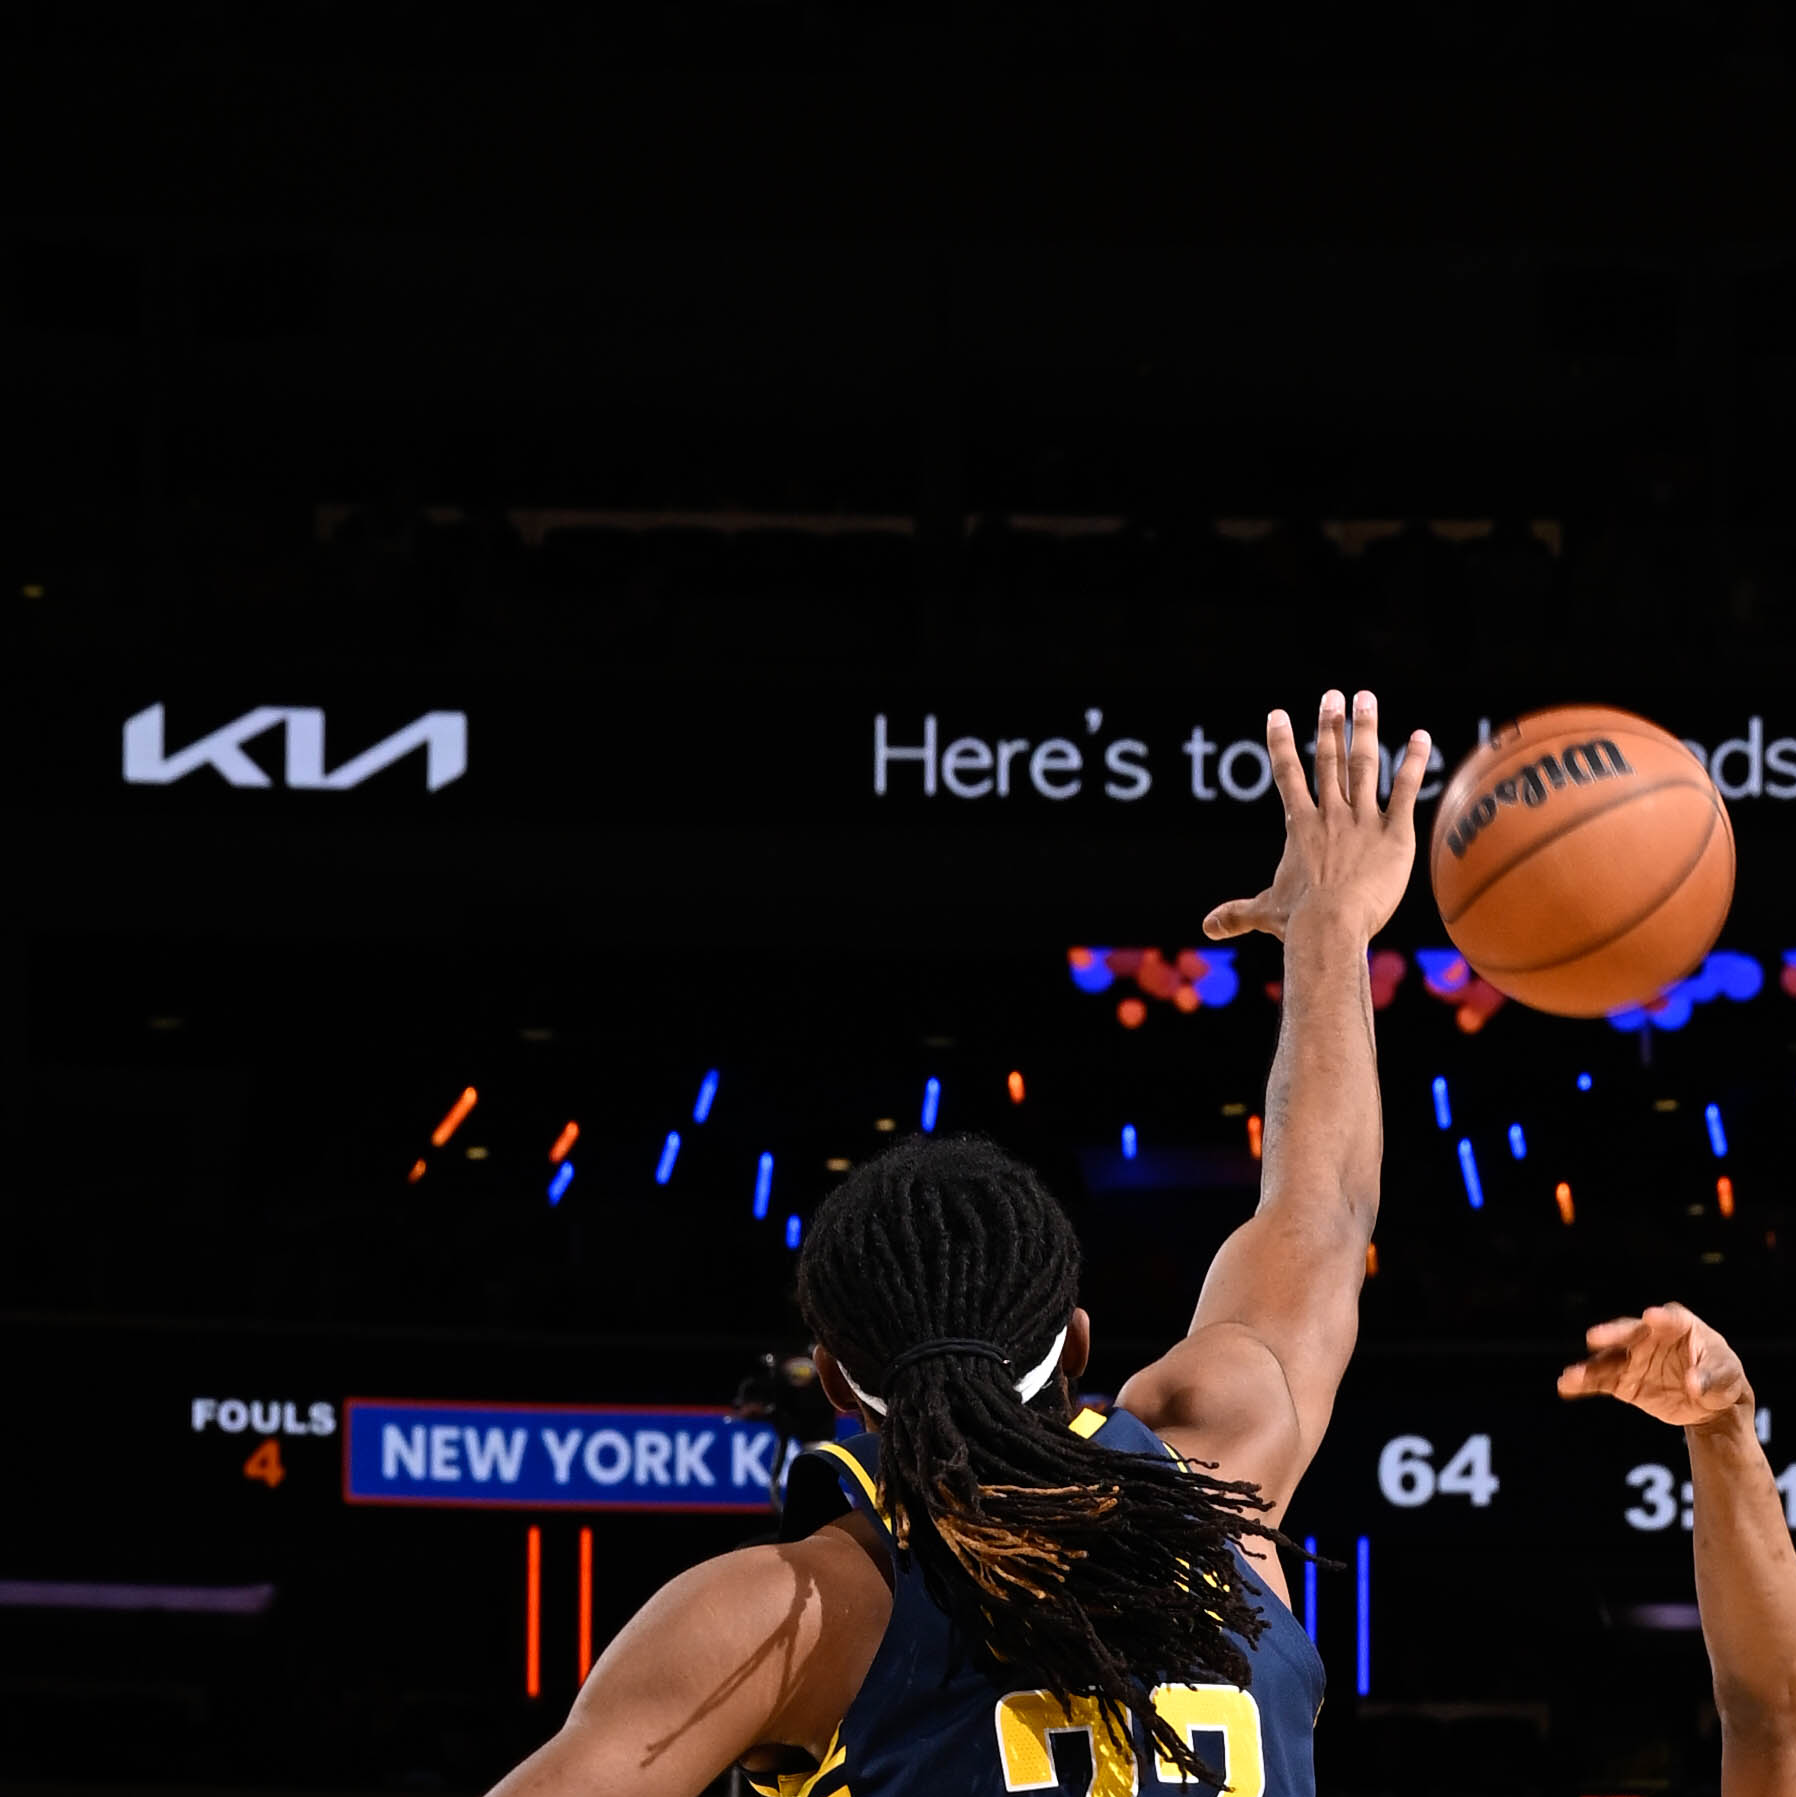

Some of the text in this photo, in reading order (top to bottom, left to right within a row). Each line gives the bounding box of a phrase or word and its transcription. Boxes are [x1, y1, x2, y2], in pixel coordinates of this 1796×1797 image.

[874, 708, 1152, 801] Here’s
[1183, 724, 1274, 802] to
[1447, 738, 1638, 858] Wilson
[191, 1397, 337, 1436] FOULS
[243, 1438, 286, 1489] 4
[383, 1425, 526, 1482] NEW
[543, 1430, 714, 1485] YORK
[1377, 1433, 1500, 1508] 64
